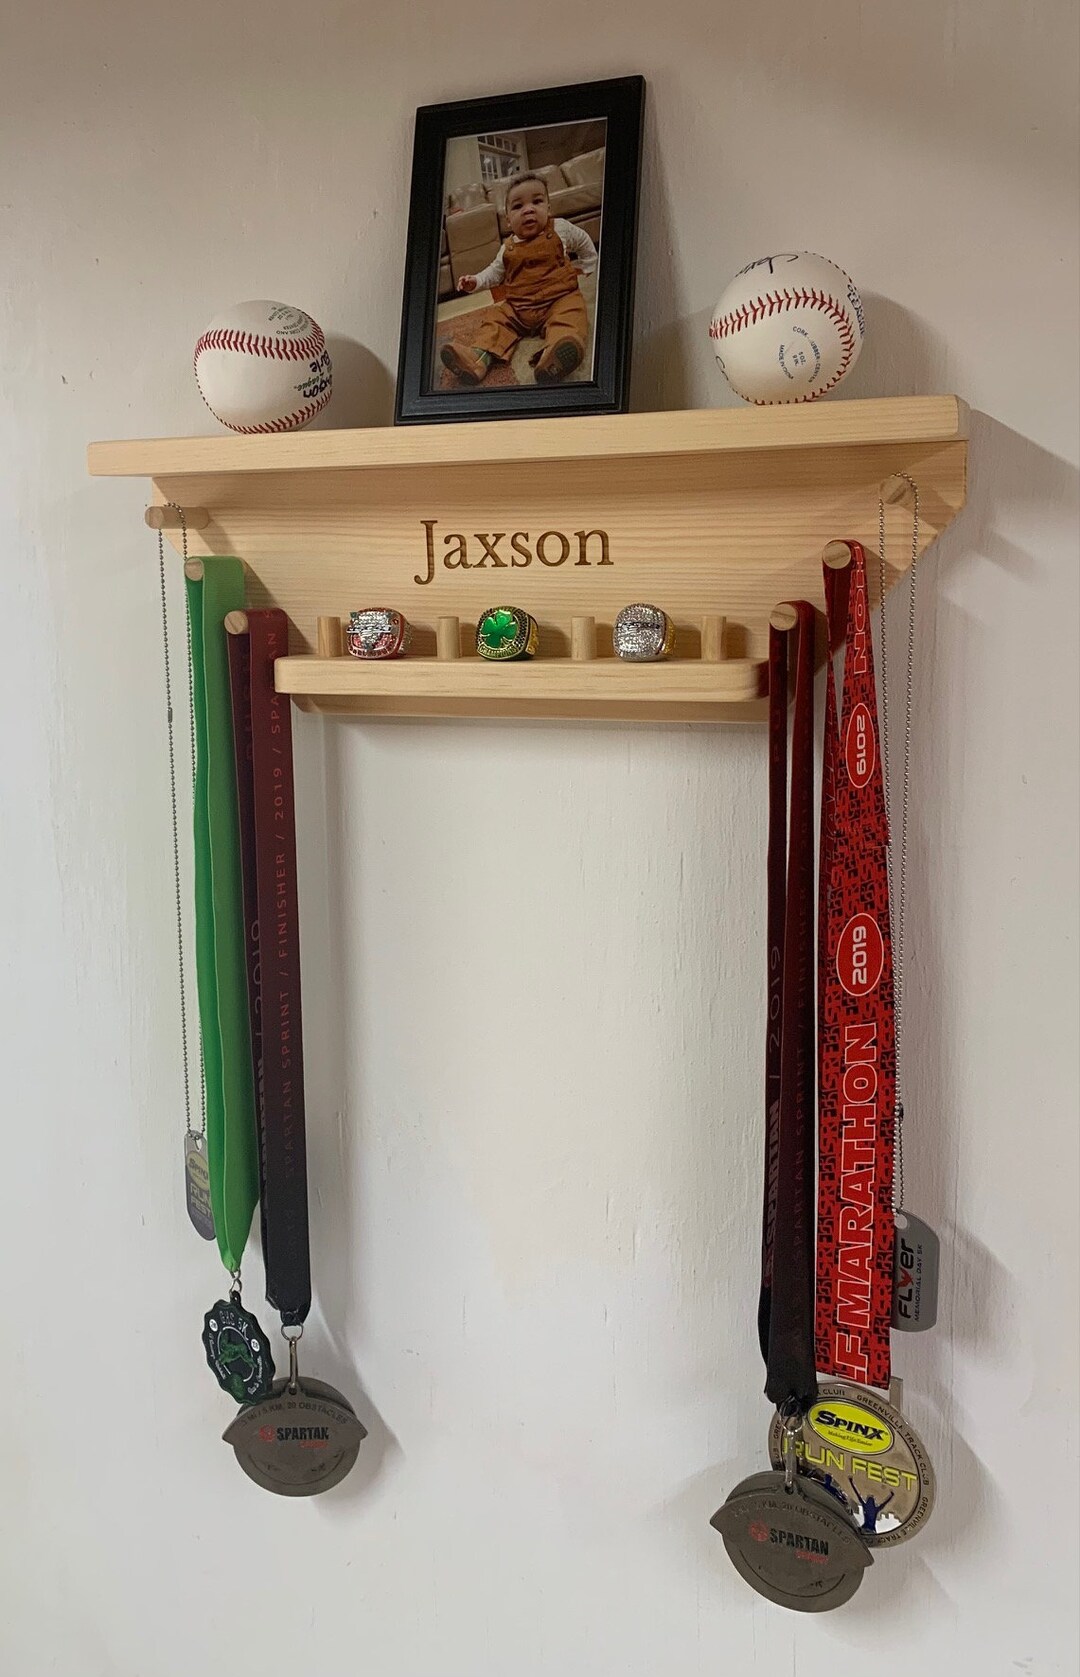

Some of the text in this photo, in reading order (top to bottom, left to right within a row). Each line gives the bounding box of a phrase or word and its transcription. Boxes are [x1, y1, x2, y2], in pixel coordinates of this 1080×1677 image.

[414, 520, 614, 585] Jaxson
[856, 714, 866, 776] 2019
[272, 767, 284, 821] 2019
[275, 852, 288, 958] FINISHER
[851, 925, 867, 984] 2019
[768, 945, 781, 1054] 2019
[279, 990, 292, 1070] SPRINT
[836, 1022, 878, 1328] MARATHON
[913, 1243, 923, 1322] MEMORIAL DAY 5K
[277, 1426, 330, 1441] SPARTAN
[298, 1402, 350, 1424] OBSTACLES
[815, 1410, 885, 1441] SPINX
[783, 1437, 918, 1493] RUN FEST
[904, 1431, 923, 1460] TRACK
[769, 1528, 830, 1557] SPARTAN
